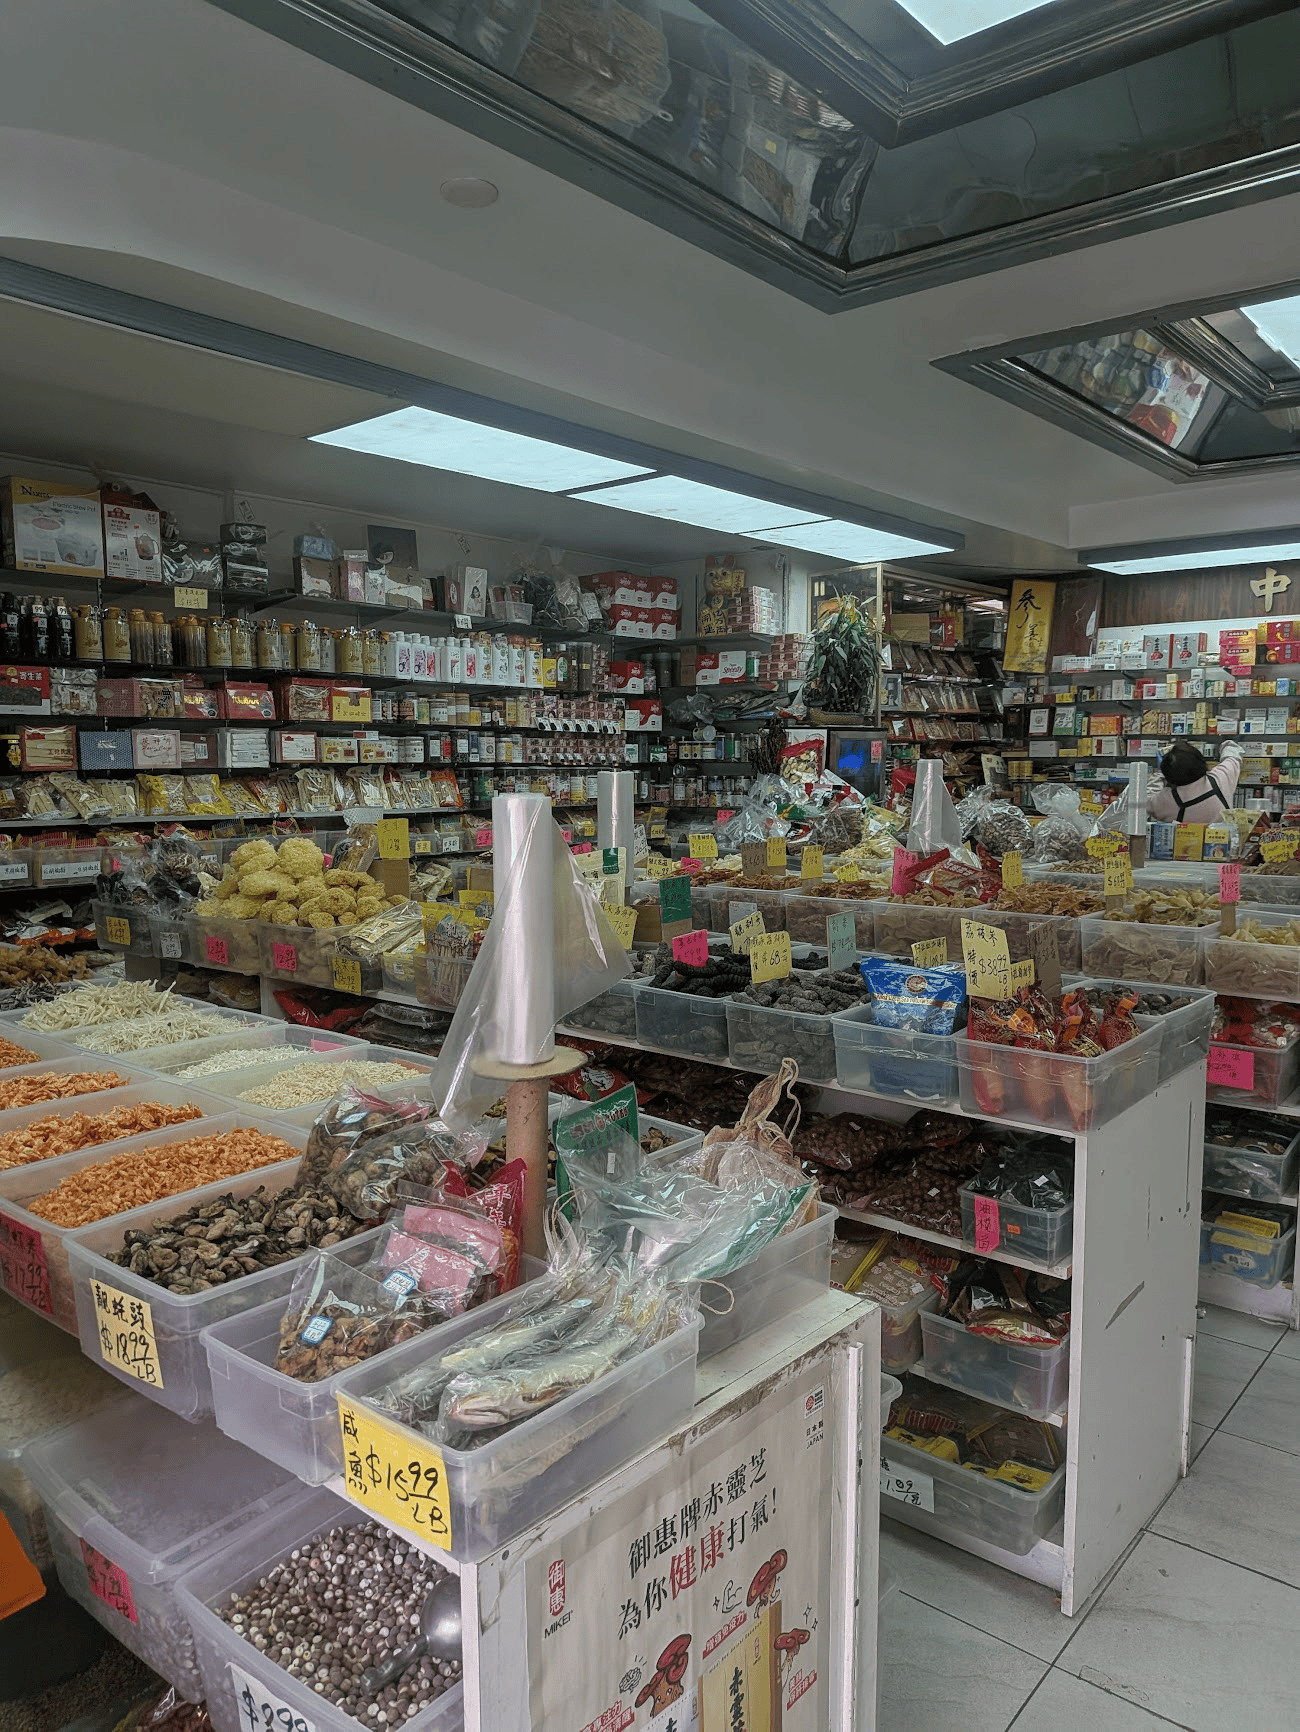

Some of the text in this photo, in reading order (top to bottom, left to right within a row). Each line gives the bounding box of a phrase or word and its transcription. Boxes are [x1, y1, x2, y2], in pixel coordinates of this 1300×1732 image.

[1250, 566, 1292, 612] 中
[722, 666, 744, 674] Speedy
[806, 1432, 824, 1450] JAPAN
[411, 1504, 449, 1535] LB
[627, 1447, 767, 1580] 御惠牌赤靈芝
[617, 1487, 776, 1640] 為你健康打氣!
[548, 1559, 566, 1617] 御惠
[544, 1610, 571, 1639] MIKEI
